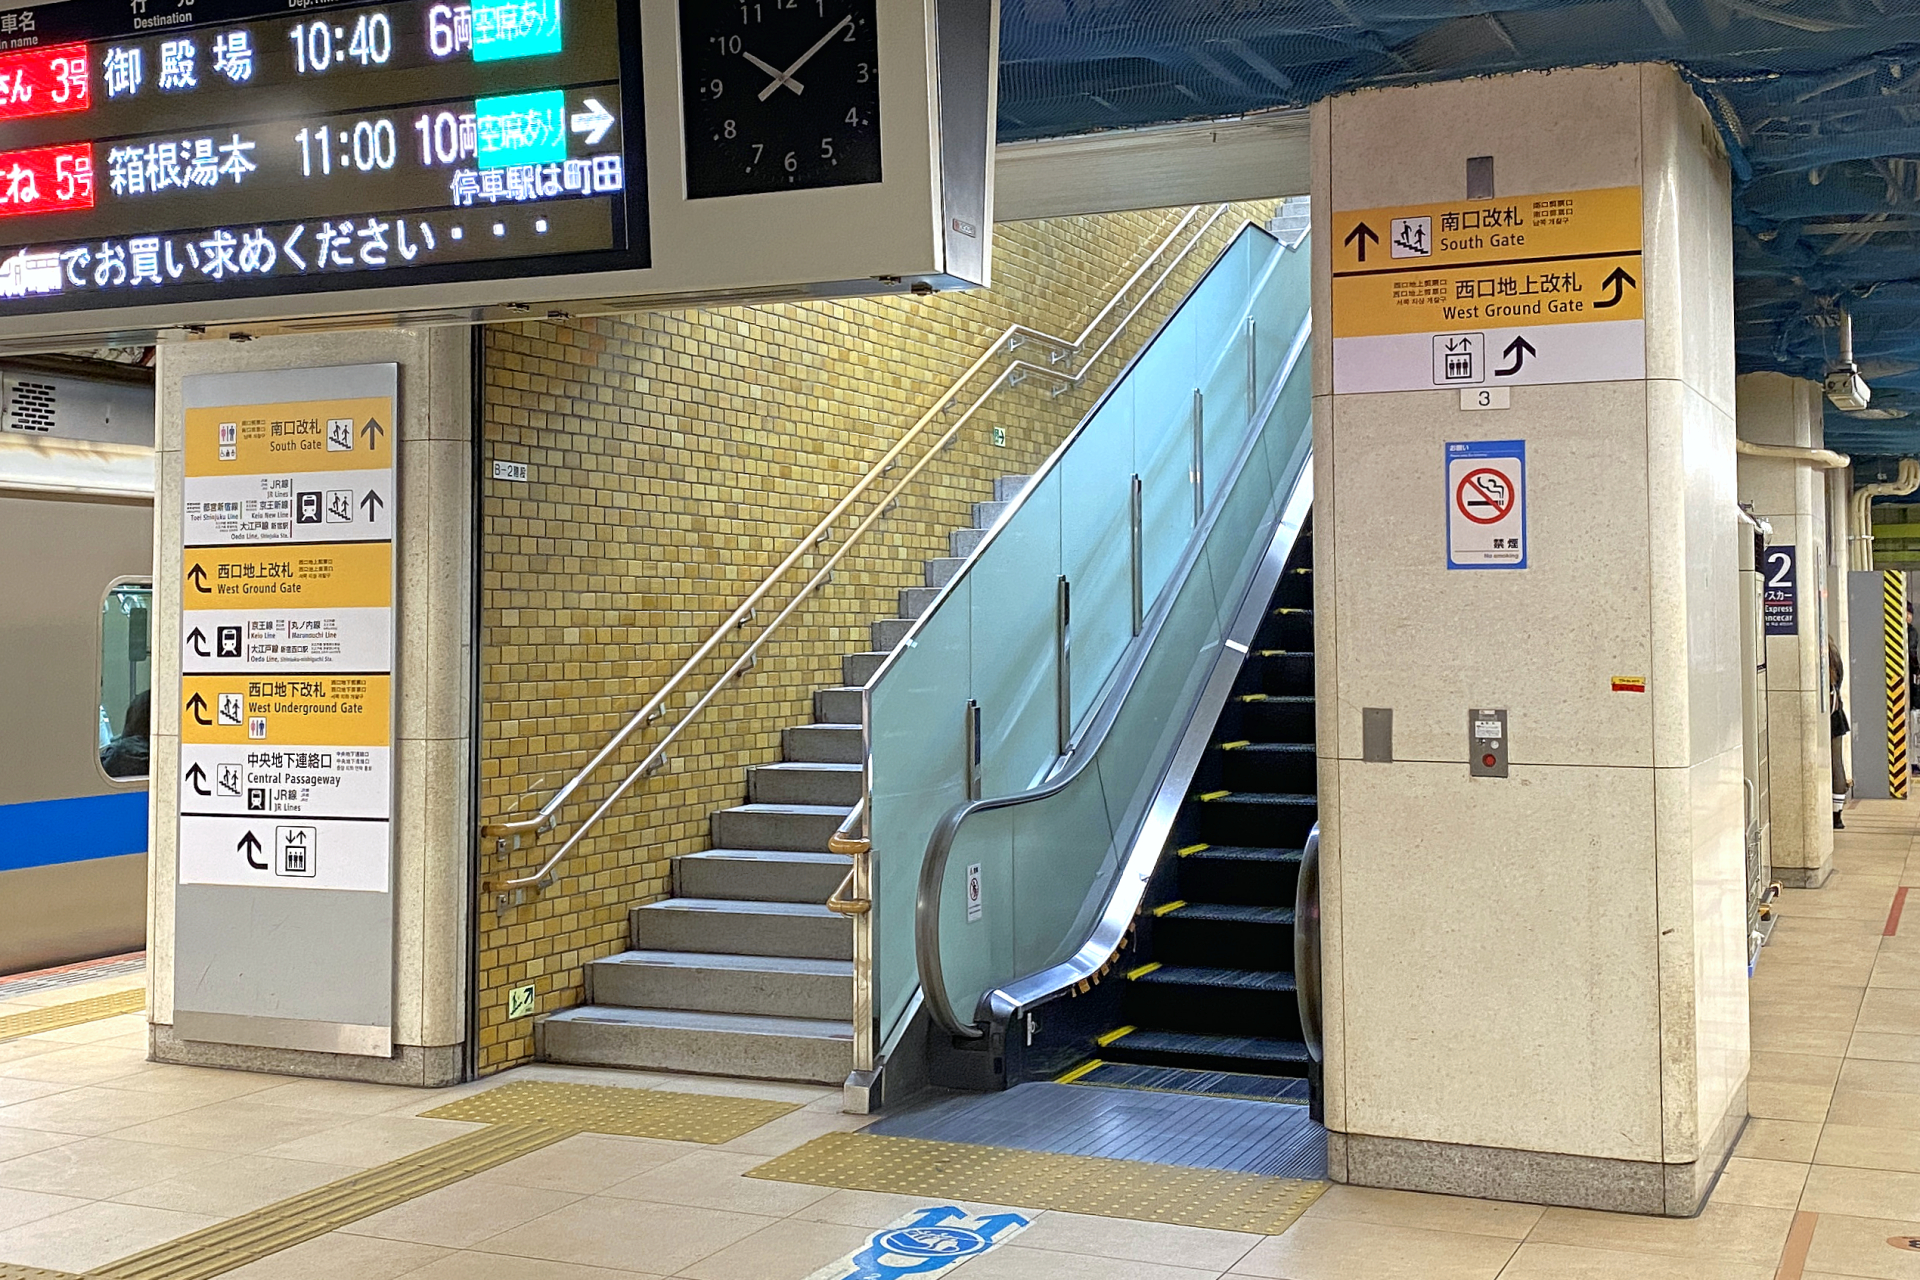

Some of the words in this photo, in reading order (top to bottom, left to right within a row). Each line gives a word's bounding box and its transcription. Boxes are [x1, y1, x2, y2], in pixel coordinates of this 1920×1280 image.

[133, 12, 193, 29] Destination
[741, 4, 761, 25] 11
[843, 22, 857, 42] 2
[10, 36, 38, 48] name
[51, 58, 88, 102] 3号
[103, 30, 253, 98] 御殿場
[289, 13, 391, 73] 10:40
[428, 5, 473, 57] 6両
[473, 0, 562, 44] 空席あり
[718, 35, 742, 56] 10
[857, 63, 869, 83] 3
[710, 79, 723, 98] 9
[845, 107, 859, 127] 4
[723, 119, 737, 139] 8
[0, 163, 40, 203] ね
[56, 155, 93, 200] 5号
[107, 133, 256, 196] 箱根湯本
[295, 119, 396, 179] 11:00
[415, 112, 478, 166] 10両
[477, 108, 566, 151] 空席あり
[752, 144, 764, 164] 7
[821, 138, 833, 158] 5
[784, 151, 797, 172] 6
[450, 156, 622, 206] 停車駅は町田
[1440, 206, 1524, 232] 南口改札
[1440, 234, 1483, 251] South
[1490, 233, 1525, 247] Gate
[1455, 271, 1582, 300] 西口地上改札
[1443, 305, 1479, 320] West
[1485, 300, 1540, 318] Ground
[1547, 299, 1583, 313] Gate
[1478, 390, 1490, 407] 3
[270, 418, 322, 437] 南口改札
[270, 439, 297, 452] South
[300, 439, 322, 450] Gate
[270, 479, 289, 489] JR線
[217, 561, 294, 579] 西口地上改札
[1767, 552, 1793, 588] 2
[217, 583, 239, 594] West
[242, 582, 277, 594] Ground
[280, 582, 301, 593] Gate
[251, 620, 273, 630] 京王線
[291, 620, 320, 630] 丸ノ内線
[249, 681, 326, 698] 西口地下改札
[249, 702, 271, 713] West
[274, 702, 337, 715] Underground
[340, 702, 363, 713] Gate
[247, 752, 332, 768] 中央地下連絡口
[247, 772, 281, 784] Central
[285, 773, 341, 787] Passageway
[274, 789, 297, 801] JR線
[274, 803, 282, 812] JR
[284, 803, 301, 812] Lines
